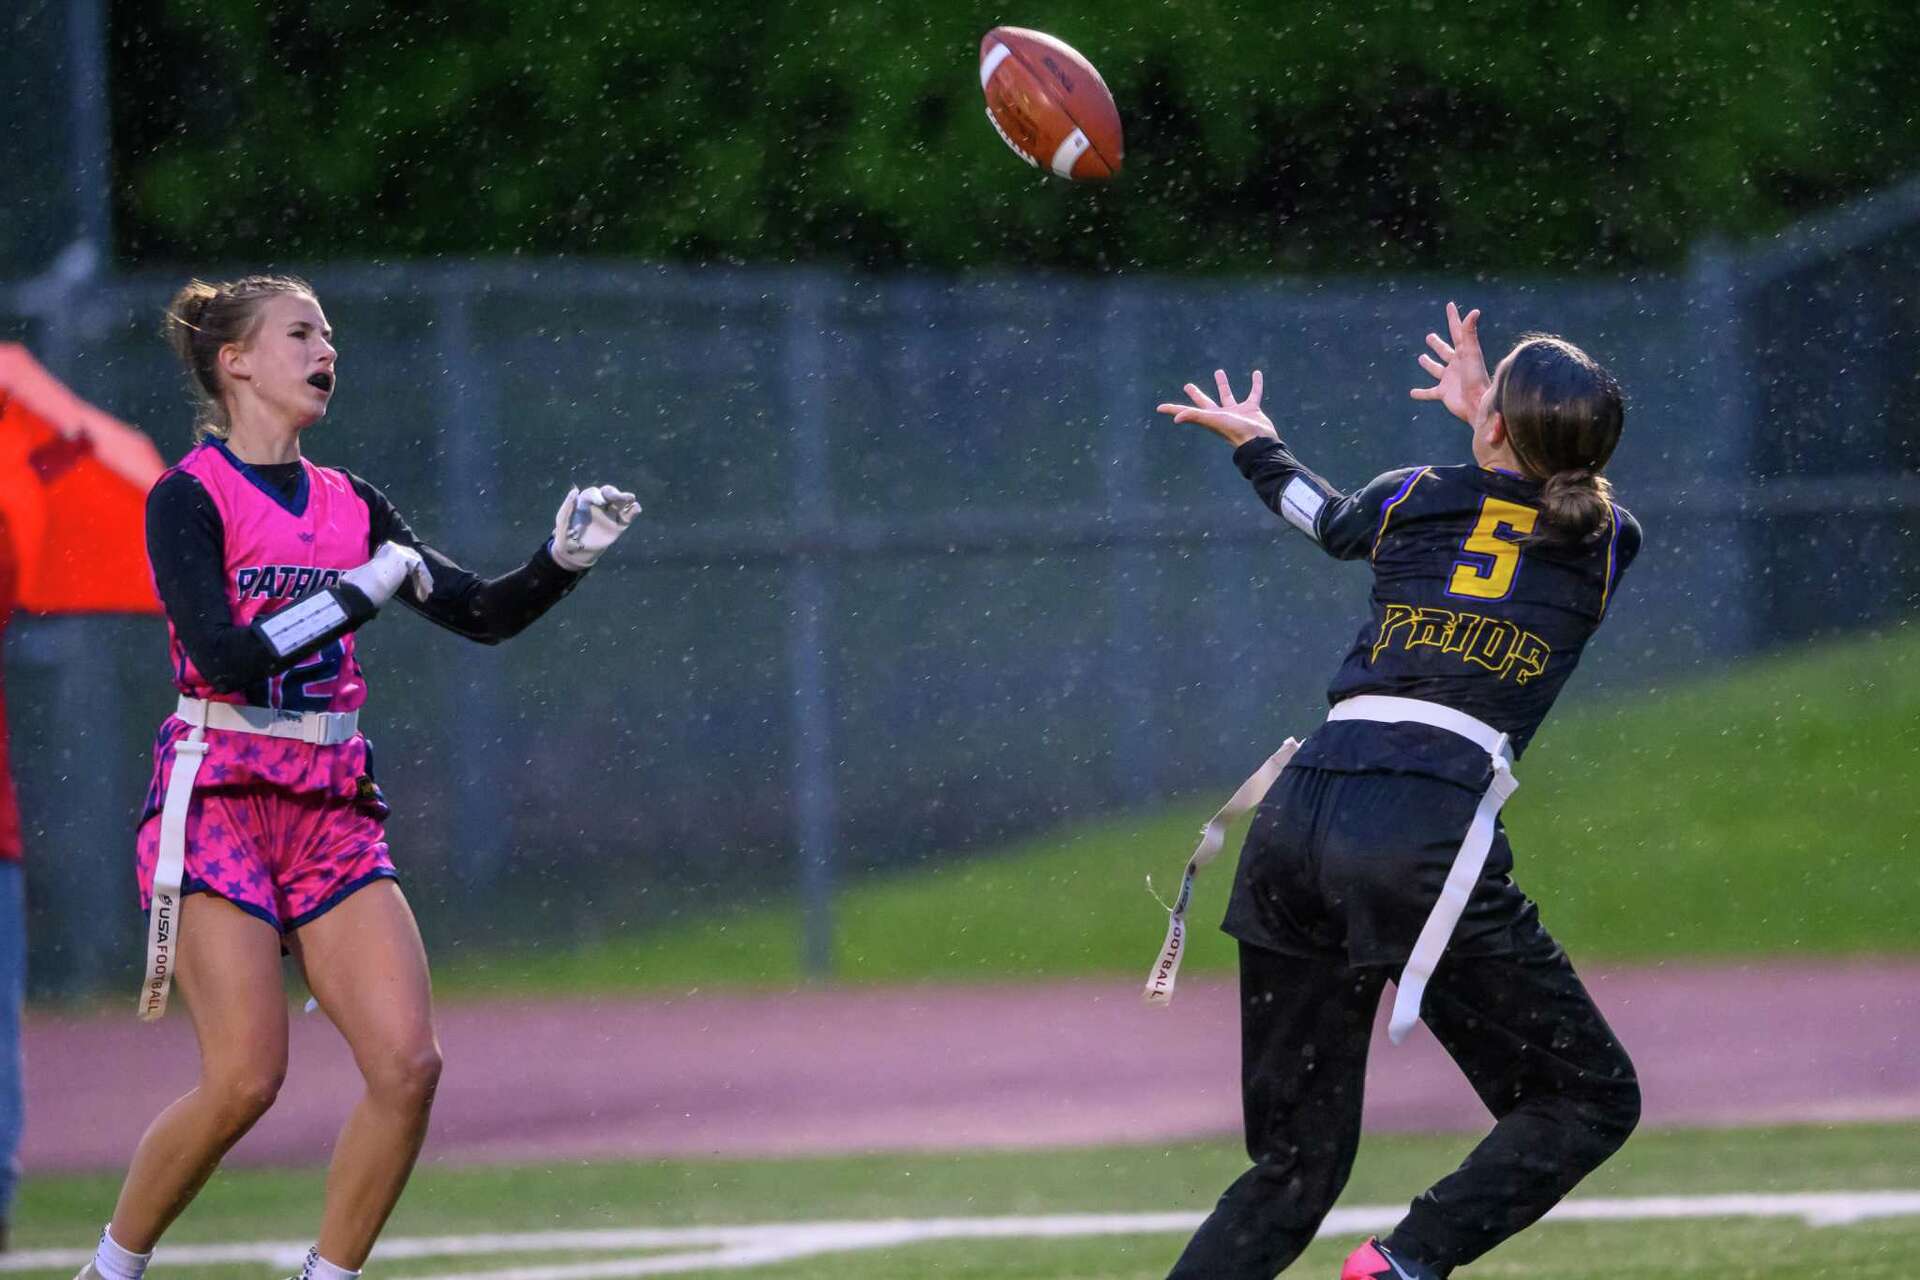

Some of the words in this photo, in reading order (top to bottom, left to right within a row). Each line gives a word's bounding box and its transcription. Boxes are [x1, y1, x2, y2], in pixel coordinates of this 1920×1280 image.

[1446, 496, 1540, 601] 5
[237, 565, 347, 600] PATRIO
[157, 907, 170, 943] USA
[148, 945, 168, 1014] FOOTBALL
